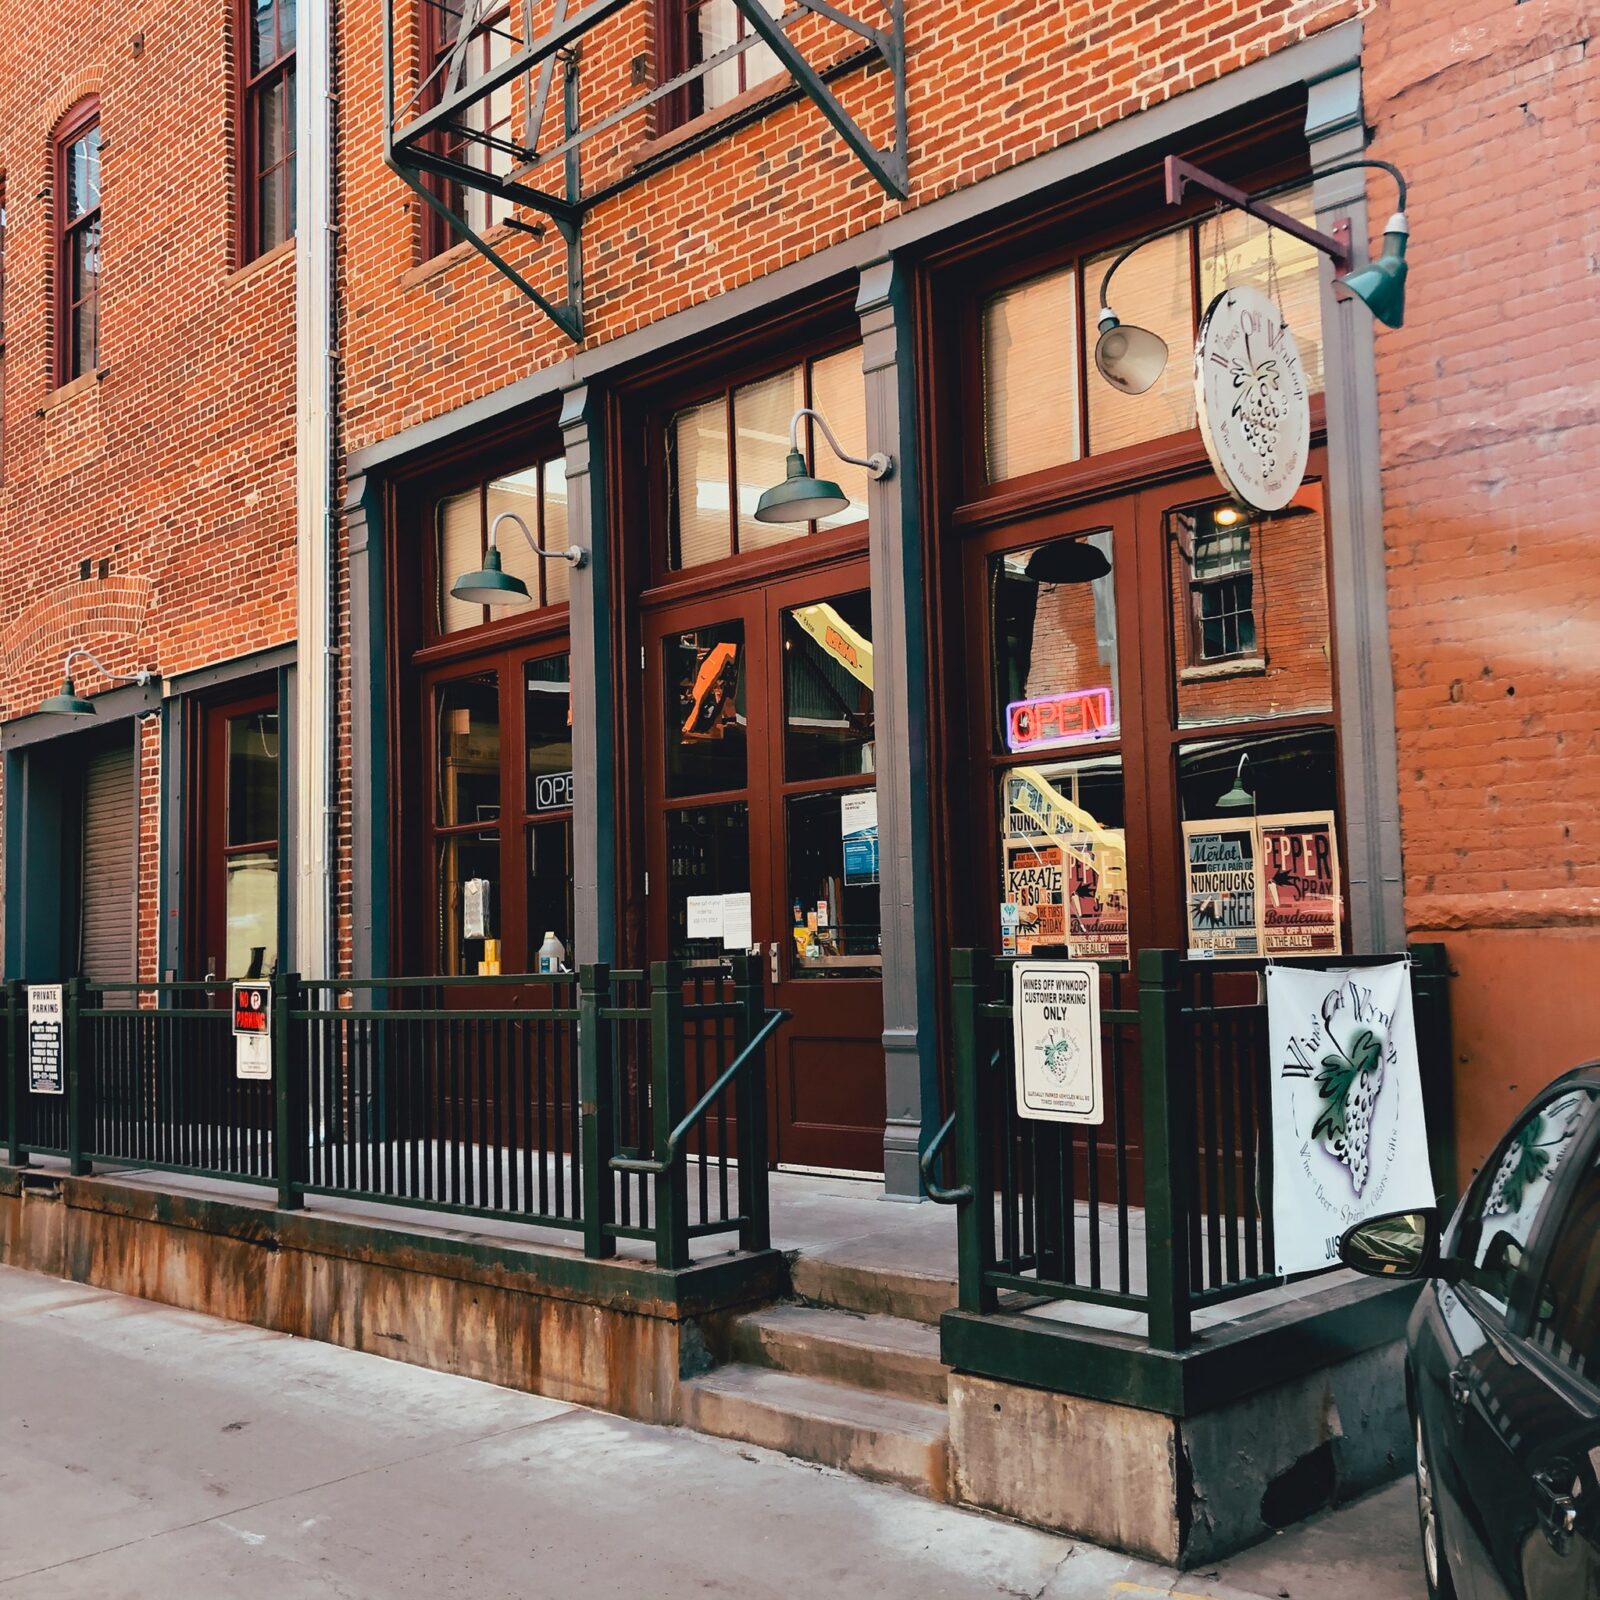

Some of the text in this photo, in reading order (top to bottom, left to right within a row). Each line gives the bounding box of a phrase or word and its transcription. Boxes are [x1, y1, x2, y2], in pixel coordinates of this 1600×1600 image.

[1013, 694, 1105, 741] OPEN
[539, 775, 574, 805] OPE
[1264, 834, 1332, 880] PEPPER
[1207, 864, 1220, 872] GET
[1009, 867, 1062, 892] KARATE
[1191, 872, 1255, 893] NUNCHUCKS
[1293, 876, 1333, 901] SPRAY
[1286, 926, 1299, 934] OFF
[1200, 939, 1213, 949] THE
[1214, 938, 1235, 949] ALLEY
[1266, 935, 1311, 946] IN THE ALLEY
[1078, 944, 1090, 954] THE
[1091, 943, 1108, 954] ALLEY
[1023, 979, 1087, 991] WINES OFF WYNKOOP
[32, 990, 57, 1001] PRIVATE
[239, 991, 249, 1009] NO
[1025, 992, 1086, 1005] CUSTOMER PARKING
[32, 1003, 59, 1014] PARKING
[1043, 1006, 1067, 1020] ONLY
[236, 1011, 266, 1029] PARKING
[1325, 1235, 1341, 1261] JUS
